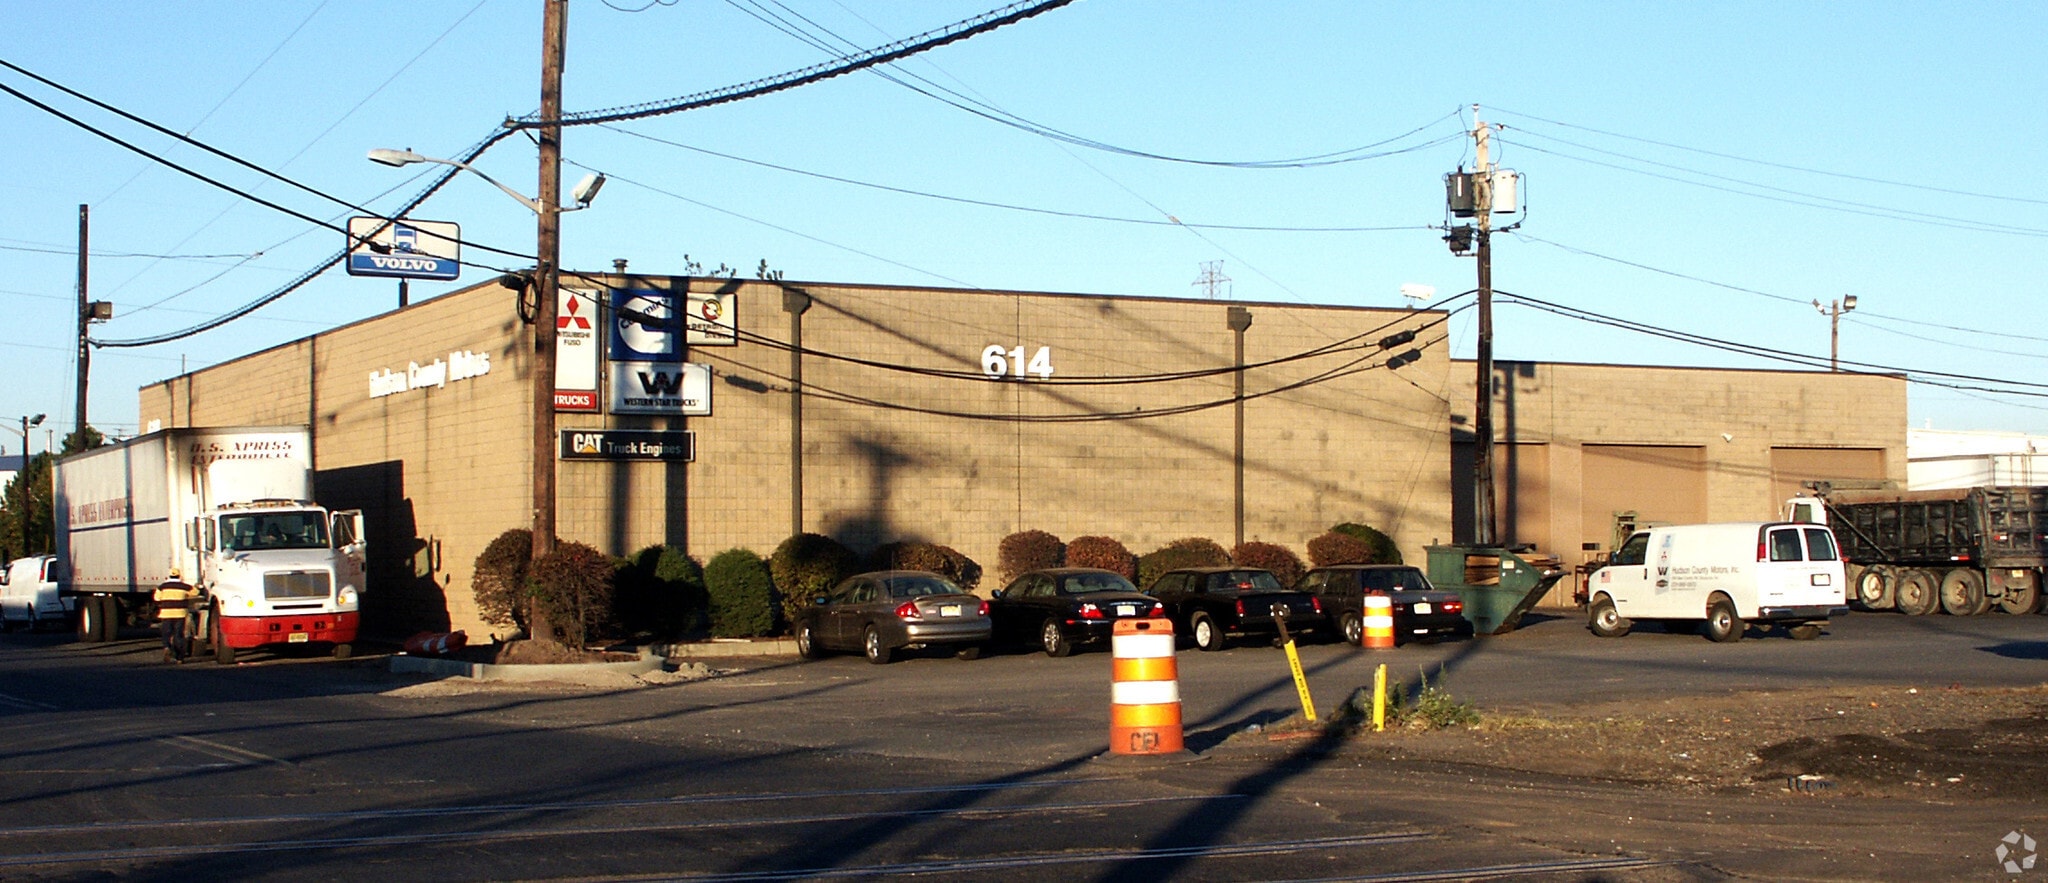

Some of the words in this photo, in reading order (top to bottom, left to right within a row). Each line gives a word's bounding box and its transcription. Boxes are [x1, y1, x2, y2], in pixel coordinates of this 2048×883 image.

[371, 257, 437, 272] VOLVO
[981, 344, 1055, 381] 614
[554, 394, 590, 405] TRUCKS
[624, 398, 654, 407] WESTERN
[655, 398, 671, 407] STAR
[573, 433, 603, 454] CAT
[608, 442, 638, 454] Truck
[640, 440, 682, 457] Engines
